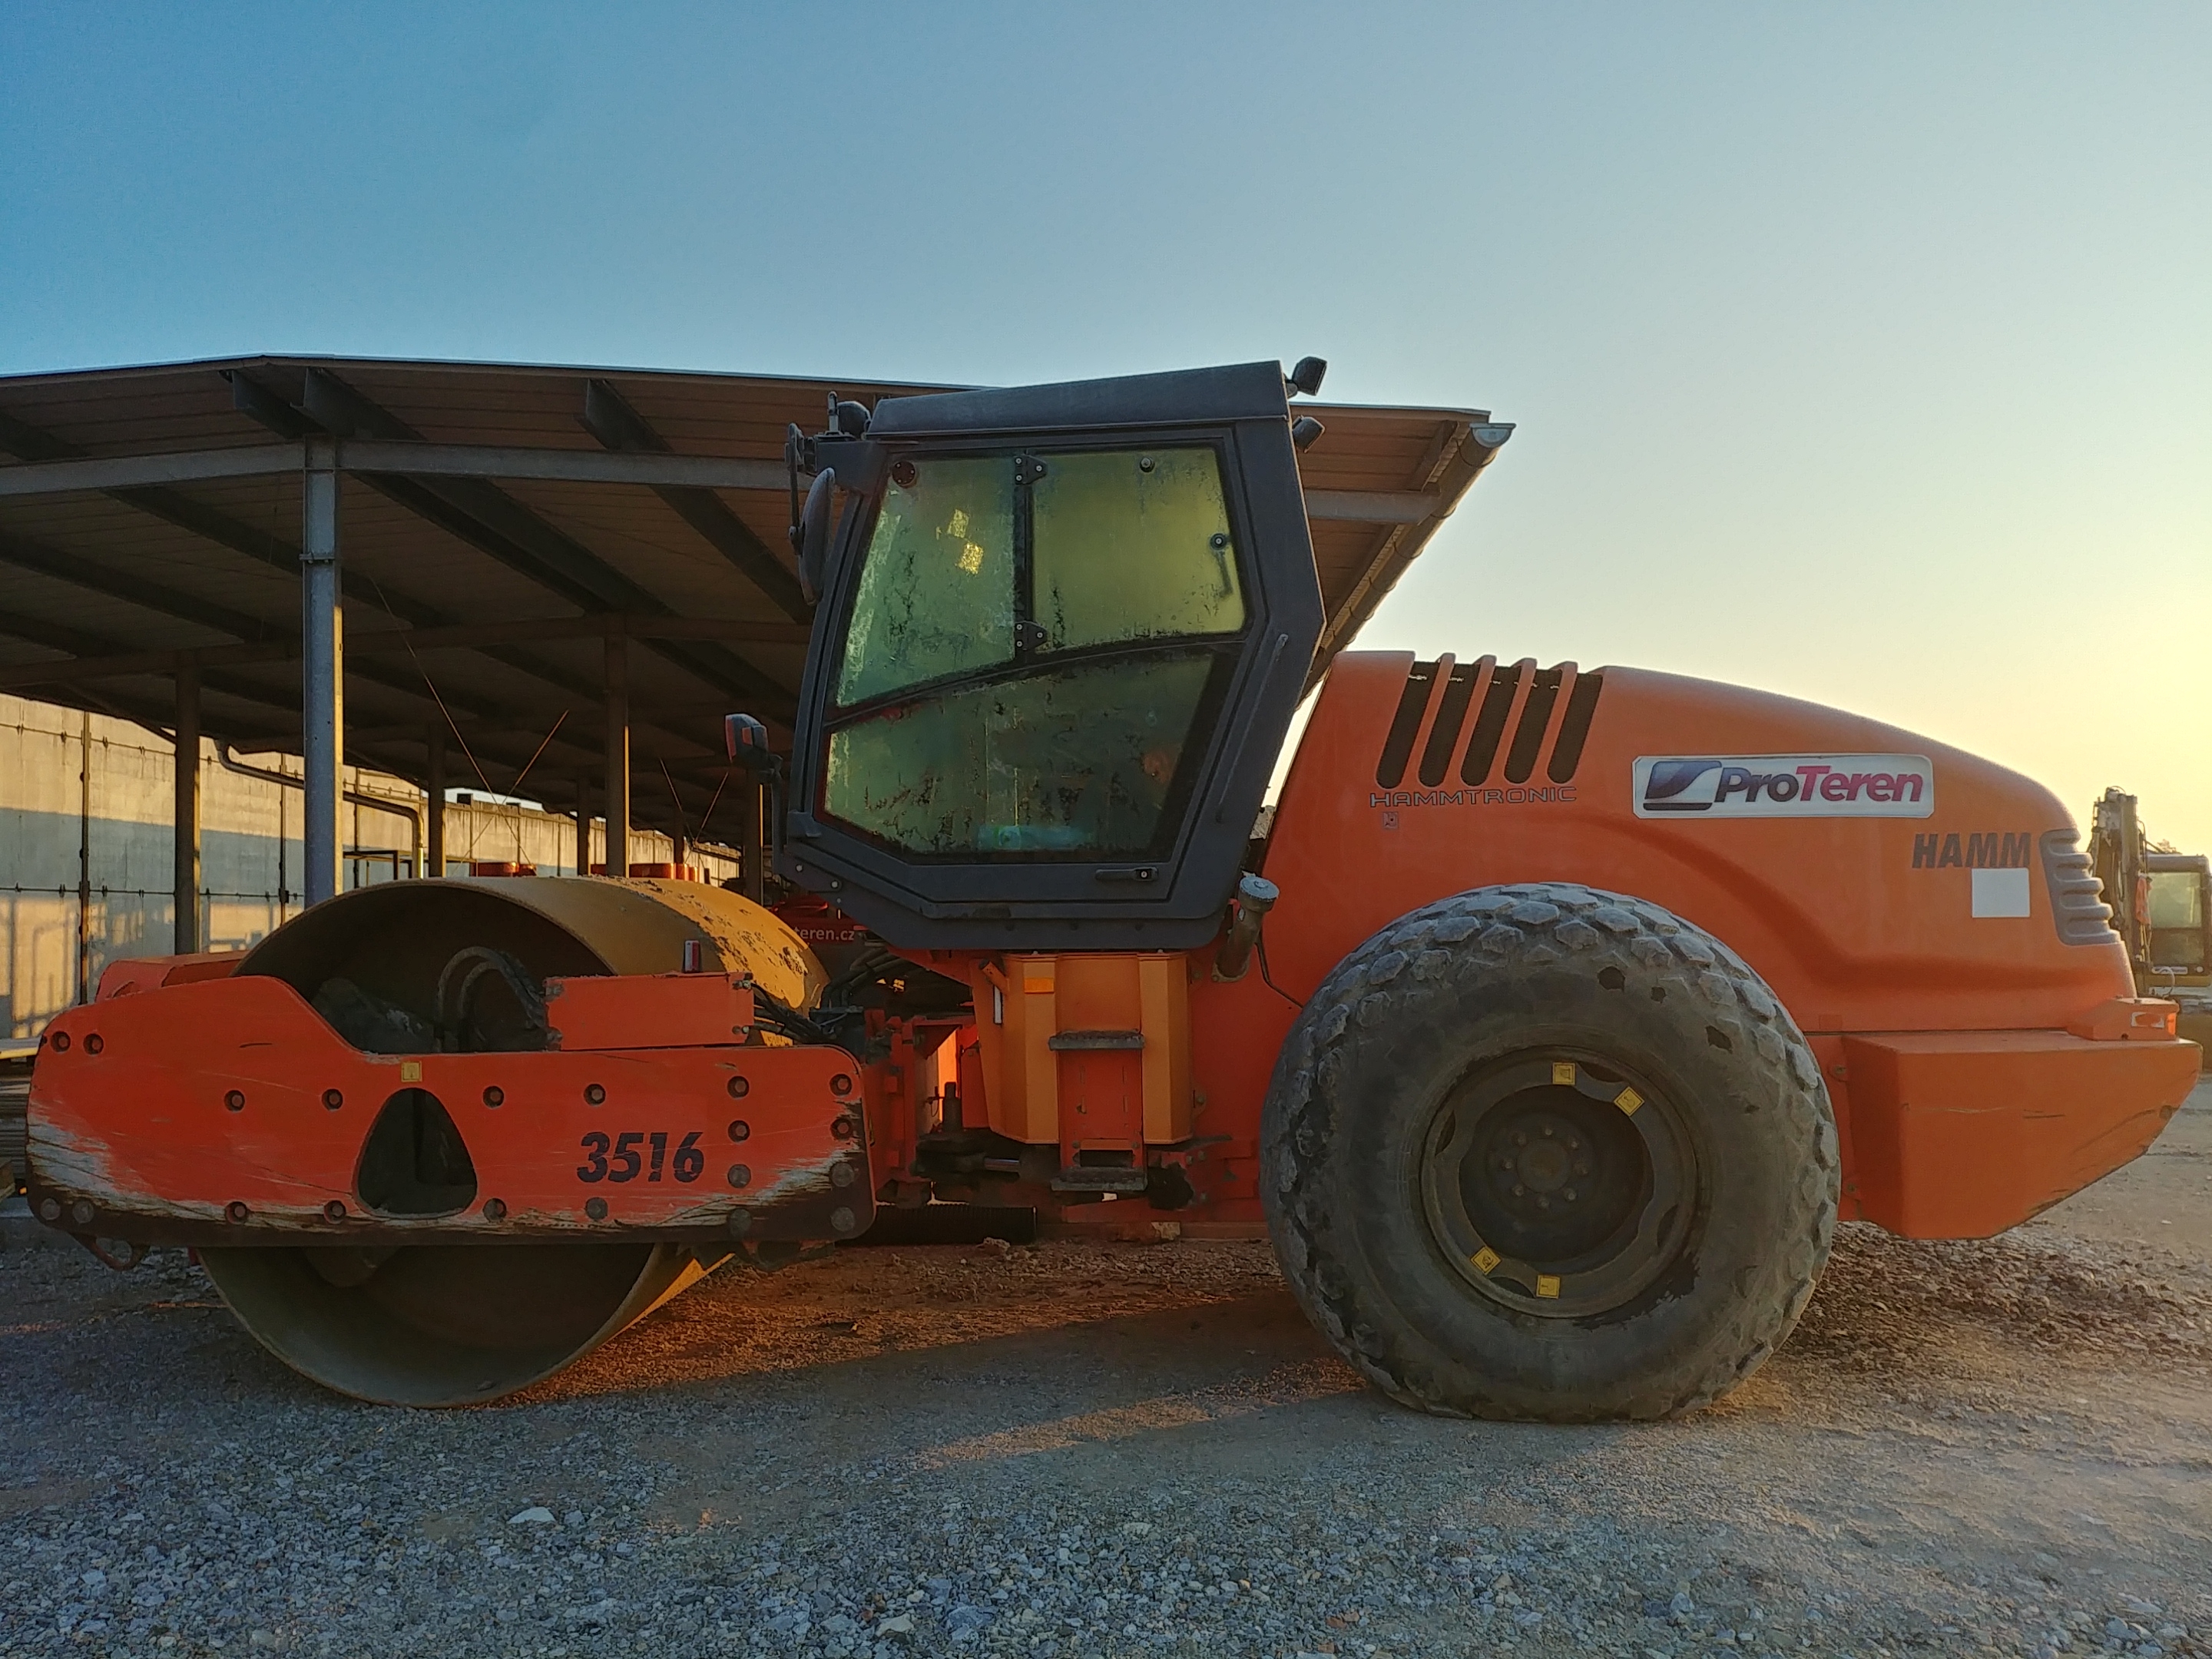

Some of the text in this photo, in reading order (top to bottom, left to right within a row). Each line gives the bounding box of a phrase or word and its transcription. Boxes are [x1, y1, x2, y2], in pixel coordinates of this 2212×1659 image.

[1369, 786, 1577, 807] HAMMTRONIC
[1714, 765, 1923, 803] ProTeren
[1912, 832, 2032, 869] HAMM
[577, 1131, 704, 1183] 3516
